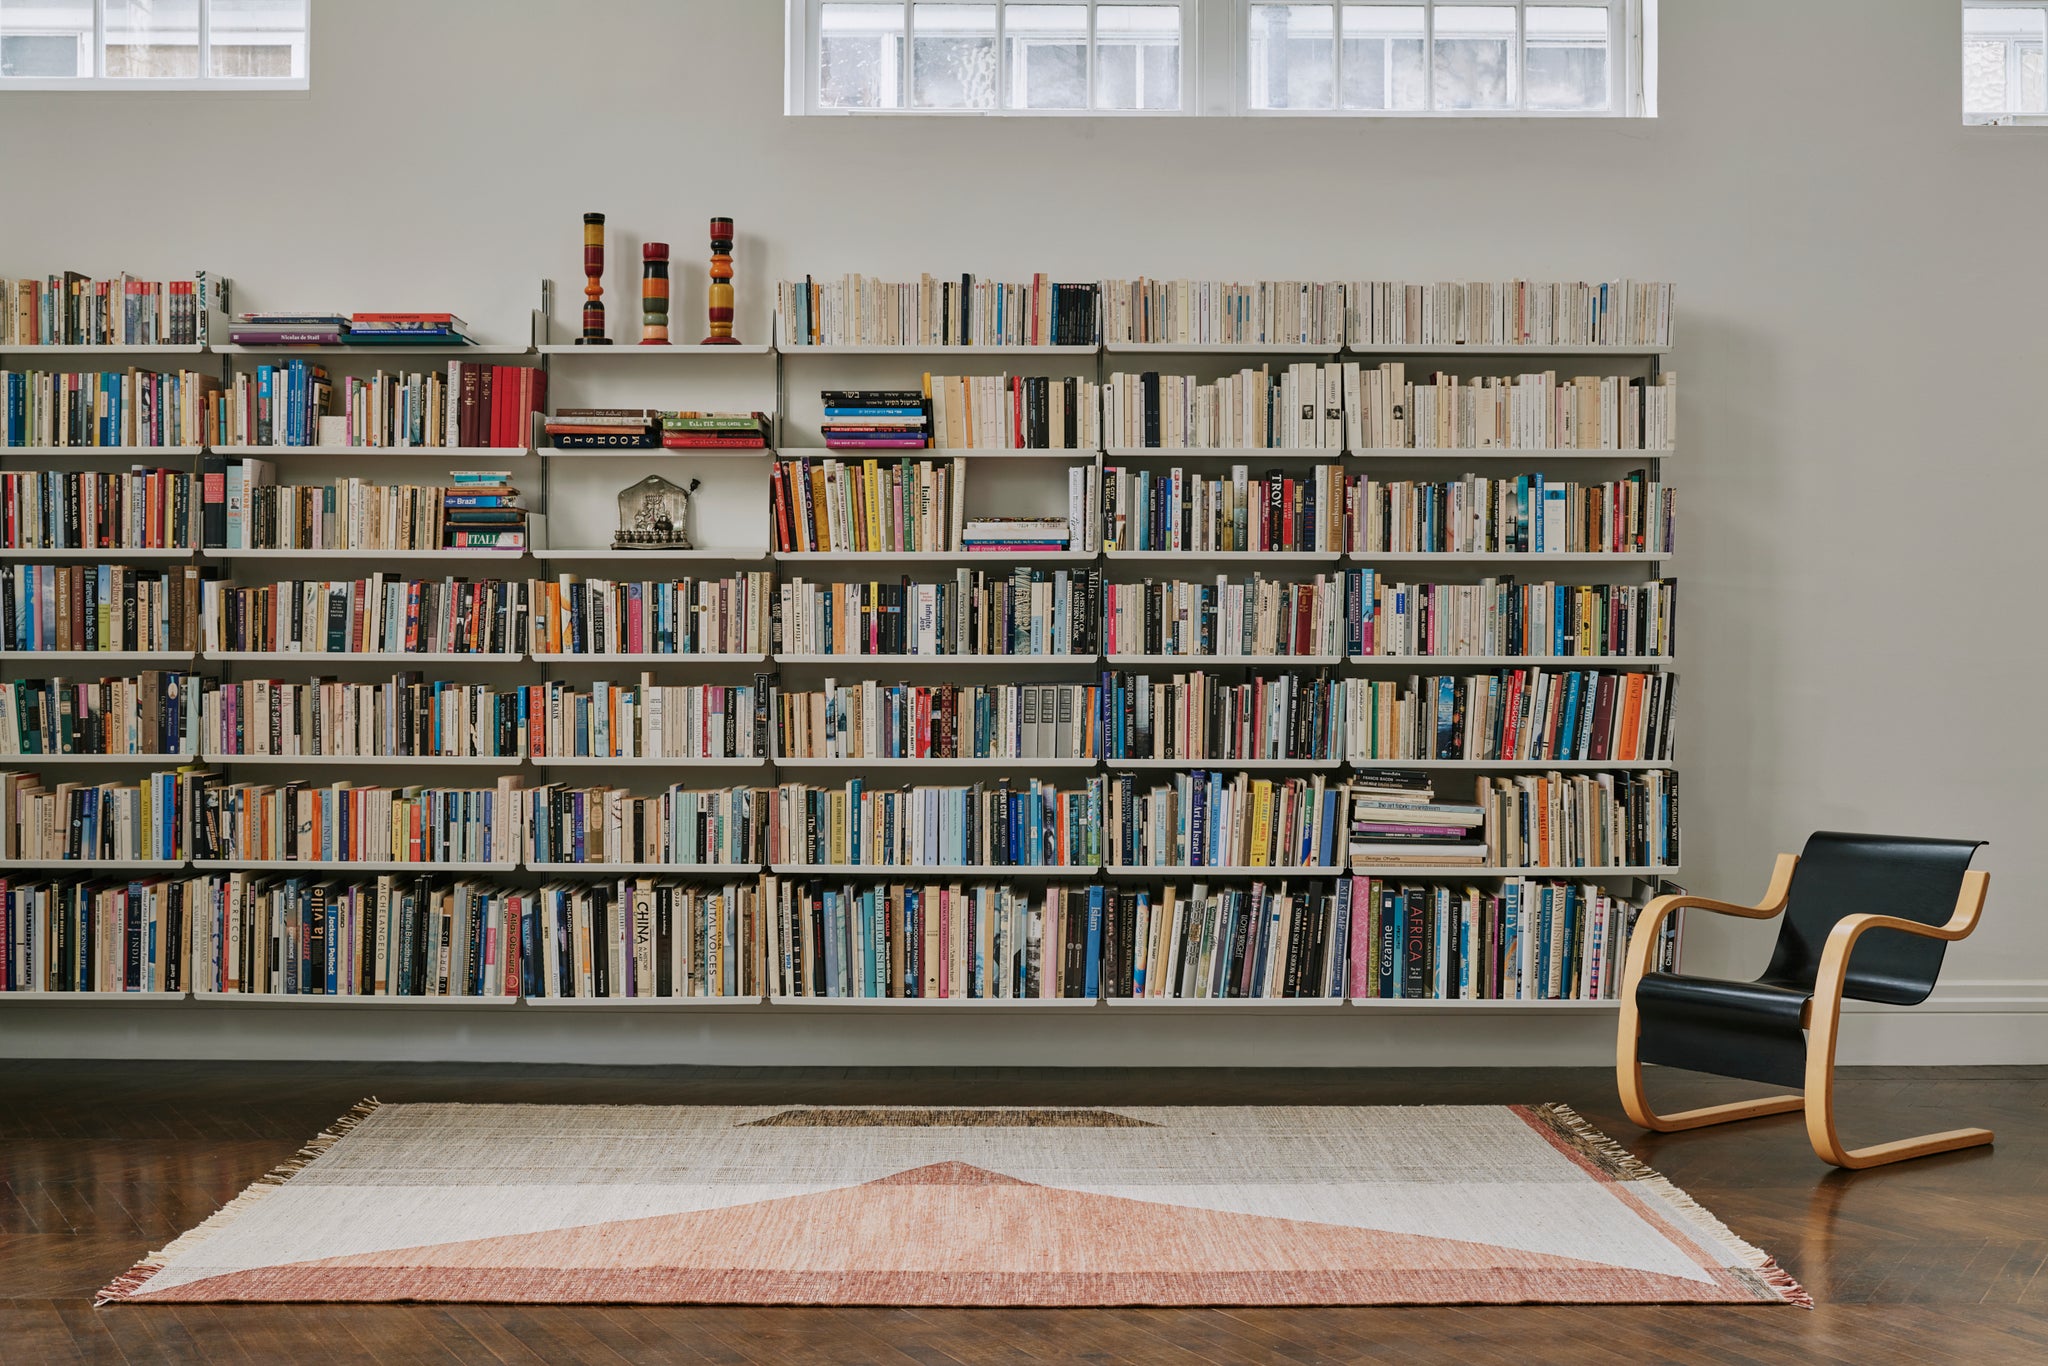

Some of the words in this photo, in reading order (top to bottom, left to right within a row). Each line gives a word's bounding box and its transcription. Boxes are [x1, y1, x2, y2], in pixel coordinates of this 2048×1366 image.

[450, 366, 458, 397] Alexander
[562, 436, 640, 445] DISHOOM
[1105, 478, 1111, 487] WE
[1271, 475, 1282, 508] TROY
[922, 486, 930, 516] Italian
[1332, 487, 1341, 527] Greenspan
[86, 581, 94, 609] Farewell
[111, 570, 122, 613] Breakthrough
[1088, 571, 1099, 599] Miles
[86, 616, 95, 627] the
[594, 600, 604, 633] MIDDLESEX
[919, 617, 927, 631] Jest
[1079, 623, 1085, 633] OF
[86, 627, 94, 640] Sea
[271, 689, 280, 710] ZADIE
[1511, 693, 1520, 729] MOSCOW
[271, 712, 280, 736] SMITH
[1670, 785, 1678, 797] THE
[807, 817, 816, 833] The
[1192, 820, 1202, 828] in
[1193, 806, 1202, 819] Art
[323, 825, 331, 851] INDIA
[1192, 830, 1202, 855] Israel
[1670, 828, 1678, 841] WAY
[807, 834, 816, 864] Italians
[232, 881, 239, 892] EL
[1340, 886, 1348, 901] KIT
[311, 889, 324, 921] ville
[1222, 895, 1230, 925] BONNARD
[1506, 894, 1517, 931] DUFY
[1544, 894, 1552, 922] MORRIS
[1553, 888, 1564, 913] JAPAN
[377, 883, 387, 960] MICHELANGELO
[404, 906, 412, 931] Marcel
[509, 913, 518, 935] Atlas
[524, 919, 532, 933] TONY
[637, 902, 649, 945] CHINA
[709, 900, 717, 931] VITAL
[876, 889, 885, 949] BOURGEOIS
[1090, 907, 1100, 931] Islam
[1239, 914, 1247, 934] LLOYD
[1338, 904, 1347, 931] KEMP
[311, 927, 324, 939] la
[328, 916, 336, 947] Jackson
[1410, 907, 1423, 961] AFRICA
[1552, 920, 1562, 958] HISTORY
[131, 937, 139, 968] INDIA
[403, 932, 412, 972] Broodthaers
[440, 930, 449, 972] ORCHIDS
[509, 936, 518, 974] Obscura
[709, 934, 717, 976] VOICES
[1235, 935, 1246, 960] WRIGHT
[1381, 925, 1393, 976] Cézanne
[1665, 941, 1674, 966] Chillida
[328, 948, 336, 976] Pollock
[876, 951, 885, 984] LOUISE
[1551, 960, 1560, 970] IN
[439, 977, 447, 993] 100
[1550, 974, 1559, 990] ART
